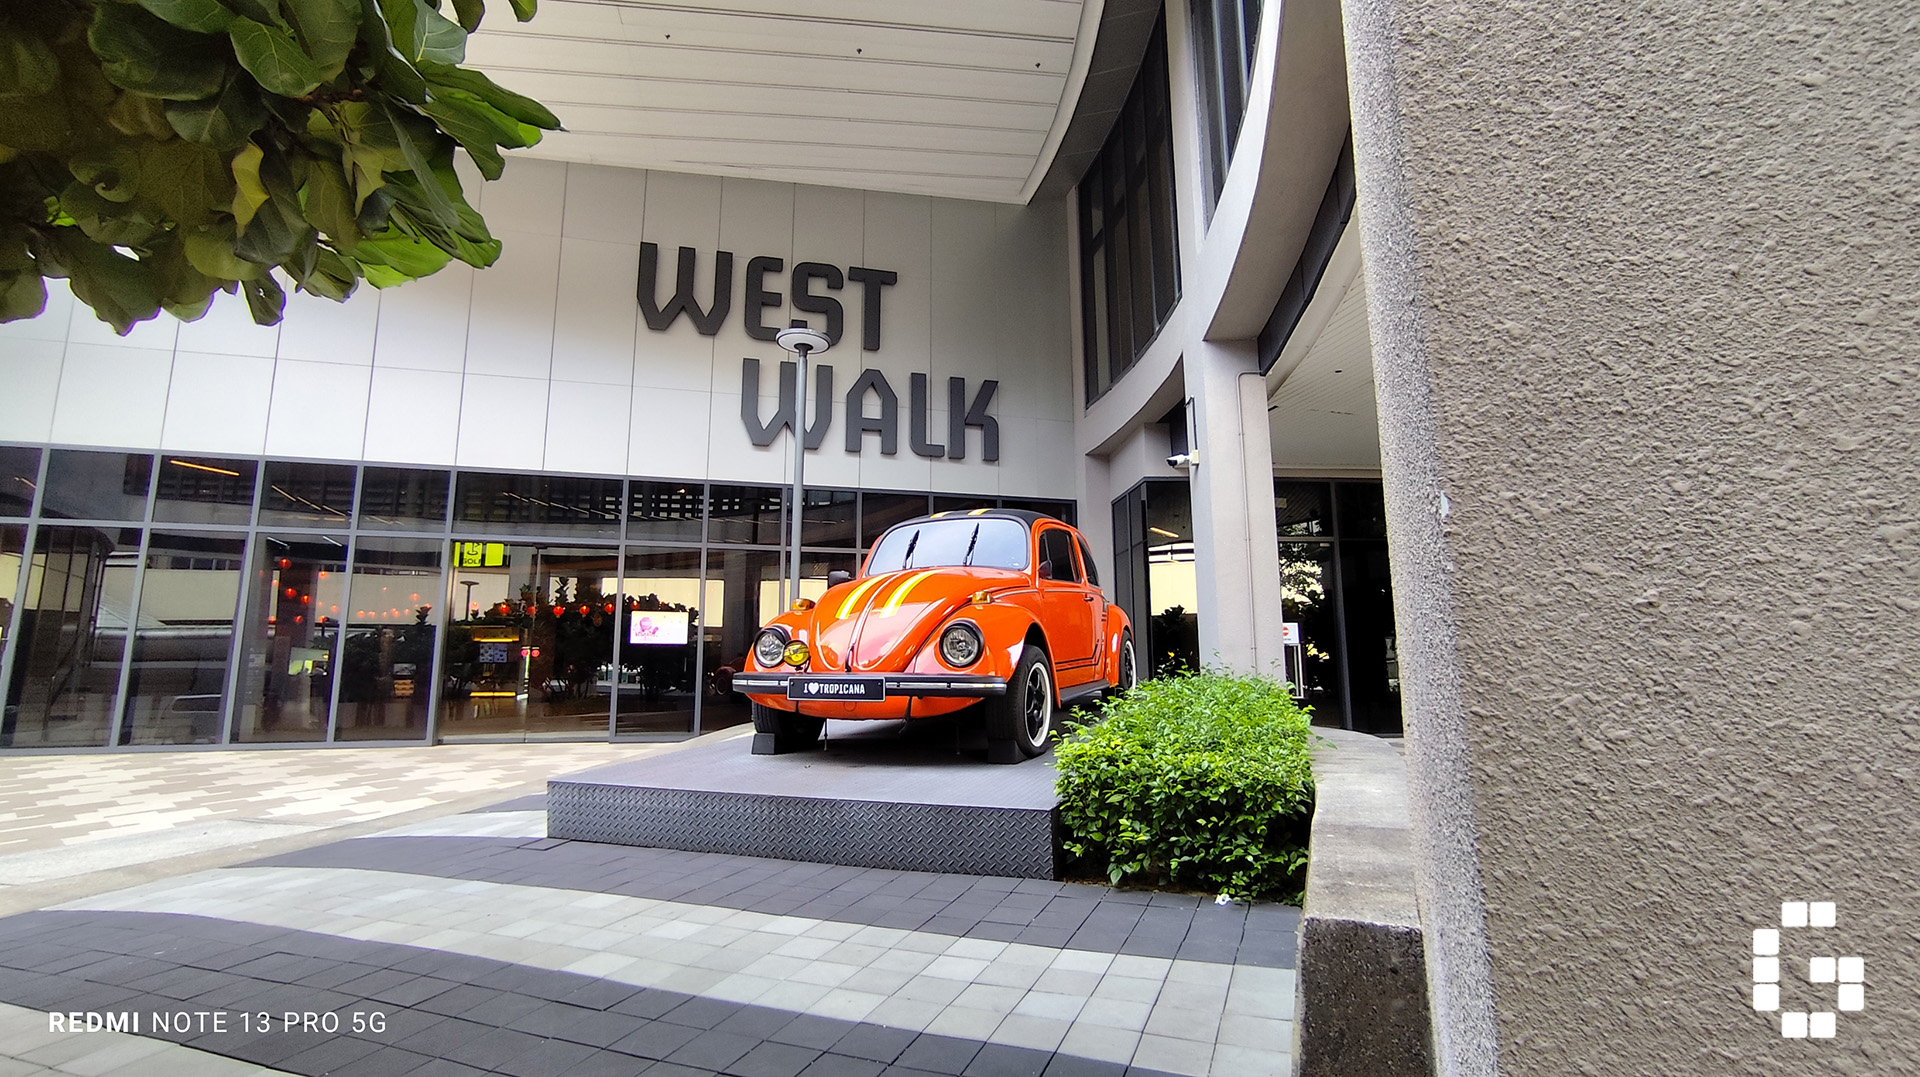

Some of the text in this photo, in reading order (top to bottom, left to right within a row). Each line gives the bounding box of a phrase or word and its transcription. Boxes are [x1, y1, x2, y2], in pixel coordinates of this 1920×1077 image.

[637, 241, 898, 352] WEST
[740, 357, 1000, 463] WALK
[819, 683, 866, 695] TROPICANA
